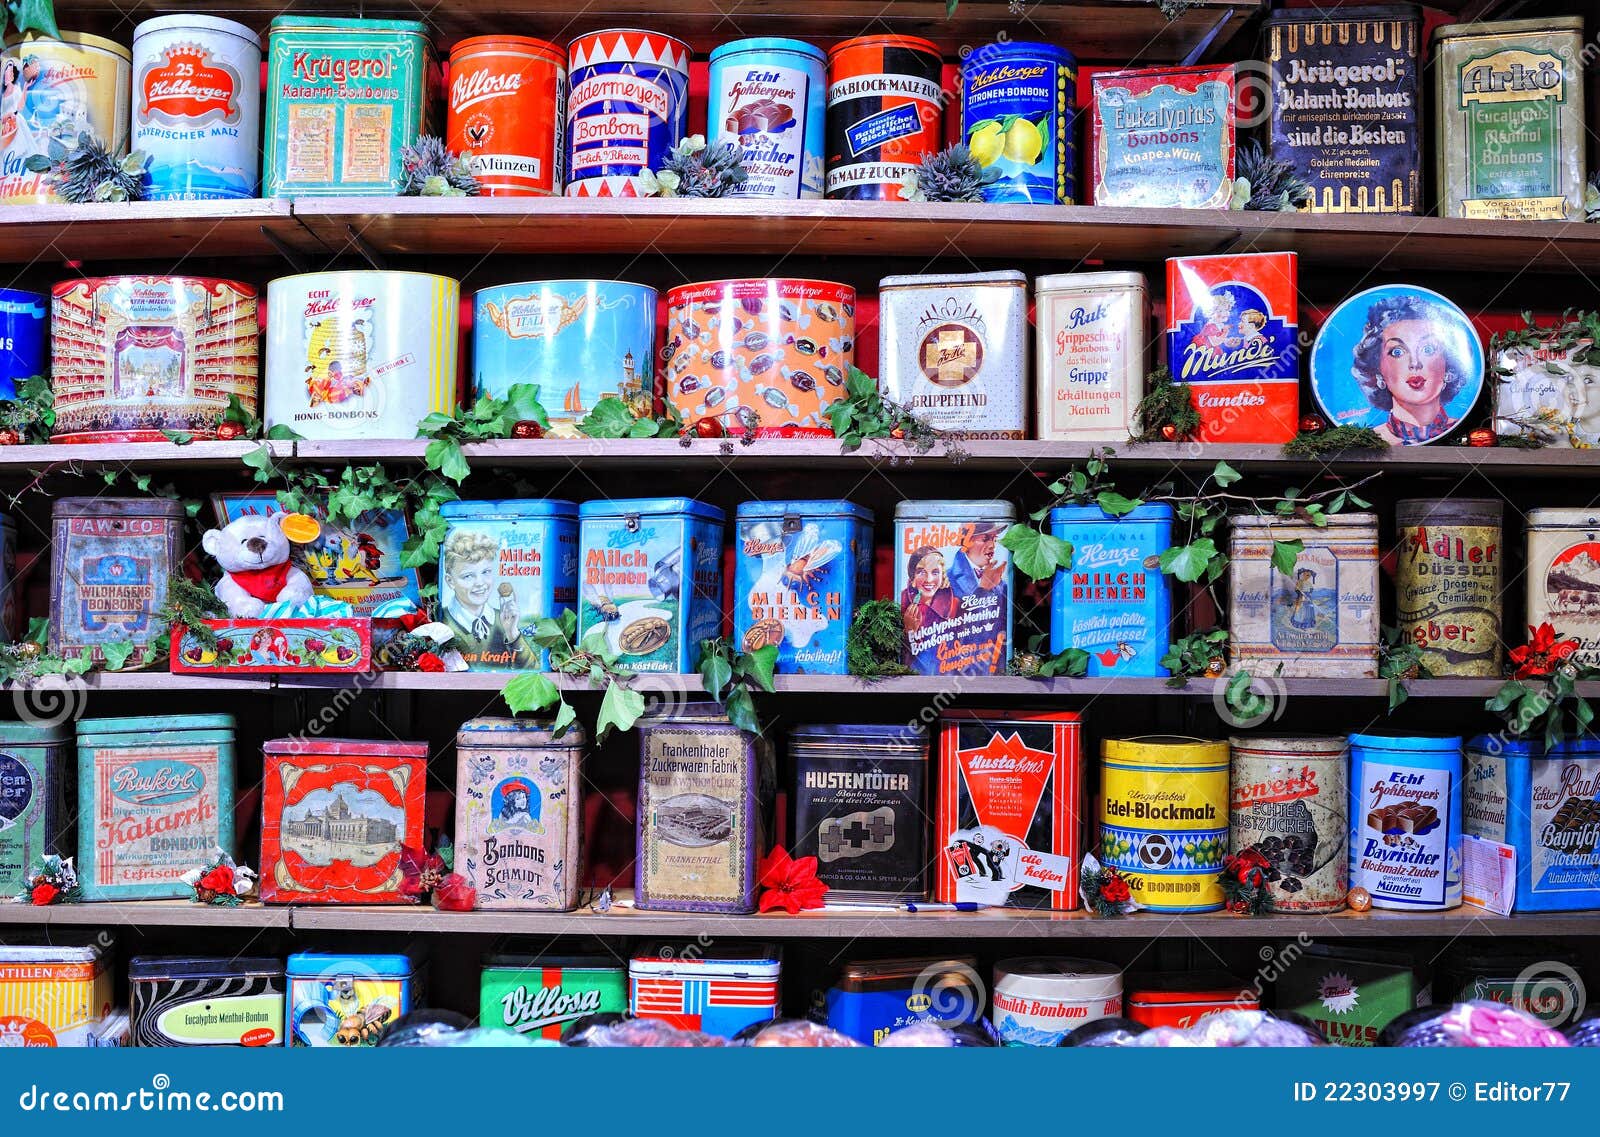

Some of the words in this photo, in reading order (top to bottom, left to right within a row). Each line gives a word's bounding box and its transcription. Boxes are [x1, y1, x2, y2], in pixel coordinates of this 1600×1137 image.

[175, 63, 194, 76] 25
[745, 71, 781, 82] Echt
[971, 65, 1047, 89] Hohberger
[1463, 61, 1560, 93] Arkö
[150, 80, 231, 102] Hohberger
[283, 84, 399, 99] Katarrh-Bonbons
[452, 68, 521, 110] Villosa
[968, 87, 1049, 106] ZITRONEN-BONBONS
[1279, 87, 1411, 110] Katarrh-Bonbons
[1114, 106, 1216, 133] Eukalyptus
[1298, 113, 1341, 123] antiseptisch
[1476, 108, 1550, 125] Eucalyptus
[138, 127, 205, 140] BAYERISCHER
[211, 127, 239, 138] MALZ
[577, 121, 643, 140] Bonbon
[1287, 126, 1322, 147] sind
[1323, 126, 1349, 145] die
[1349, 124, 1407, 146] Besten
[1127, 130, 1199, 148] Bonbons
[1311, 159, 1344, 167] Goldene
[1345, 158, 1380, 167] Medaillen
[1482, 150, 1544, 165] Bonbons
[1320, 171, 1370, 179] Ehrenpreise
[732, 182, 775, 193] München
[1476, 184, 1488, 193] Die
[1482, 200, 1543, 208] Vorzüglich
[308, 290, 331, 299] ECHT
[780, 285, 823, 297] Hohberger
[1069, 346, 1109, 354] Bonbons
[1070, 368, 1108, 384] Grippe
[913, 393, 987, 408] GRIPPEFEIND
[1058, 389, 1121, 401] Erkältungen
[1198, 391, 1265, 408] Candies
[1069, 404, 1111, 416] Katarrh
[607, 527, 658, 548] Henze
[1410, 527, 1497, 563] Adler
[500, 549, 541, 562] Milch
[744, 539, 784, 557] Henze
[1078, 544, 1140, 567] Henze
[586, 548, 647, 567] Milch
[499, 563, 541, 577] Ecken
[586, 568, 648, 585] Bienen
[1073, 573, 1146, 585] MILCH
[1444, 579, 1478, 593] Drogen
[80, 586, 151, 598] WILDHAGENS
[358, 591, 402, 604] BONBONS
[752, 592, 841, 605] MILCH
[1073, 587, 1146, 599] BIENEN
[1438, 592, 1488, 605] Chemikalien
[88, 600, 143, 611] BONBONS
[961, 594, 998, 611] Henze
[752, 607, 841, 621] BIENEN
[1072, 616, 1108, 633] köstlich
[1110, 613, 1145, 629] gefüllte
[911, 631, 955, 656] Bonbons
[957, 628, 971, 639] mit
[972, 625, 983, 635] der
[1072, 628, 1148, 648] Delikatesse!
[480, 651, 517, 663] Kraft!
[795, 650, 842, 664] fabelhaft!
[631, 661, 674, 671] köstlich!
[662, 743, 730, 758] Frankenthaler
[652, 758, 739, 773] Zuckerwaren-Fabrik
[113, 766, 200, 793] Rukol
[805, 769, 909, 791] HUSTENTÖTER
[1389, 772, 1425, 785] Echt
[836, 789, 878, 798] Bonbons
[1128, 790, 1186, 803] Ungefärbtes
[1533, 785, 1558, 802] Echter
[1107, 798, 1216, 820] Edel-Blockmalz
[1252, 801, 1306, 818] ECHTER
[150, 836, 216, 851] BONBONS
[483, 836, 545, 865] Bonbons
[117, 852, 173, 862] Wirkungsvoll
[1363, 838, 1440, 865] Bayrischer
[665, 855, 723, 864] FRANKENTHAL
[1021, 854, 1043, 865] die
[1024, 865, 1064, 882] helfen
[1361, 860, 1440, 878] Blockmalz-Zucker
[484, 868, 543, 888] SCHMIDT
[1383, 874, 1411, 884] garantiert
[1148, 881, 1200, 893] BONBON
[1376, 881, 1422, 895] München
[501, 985, 601, 1026] Villosa
[184, 1012, 218, 1026] Eucalyptus
[219, 1011, 269, 1025] Menthol-Bonbon
[243, 1036, 258, 1044] Extra
